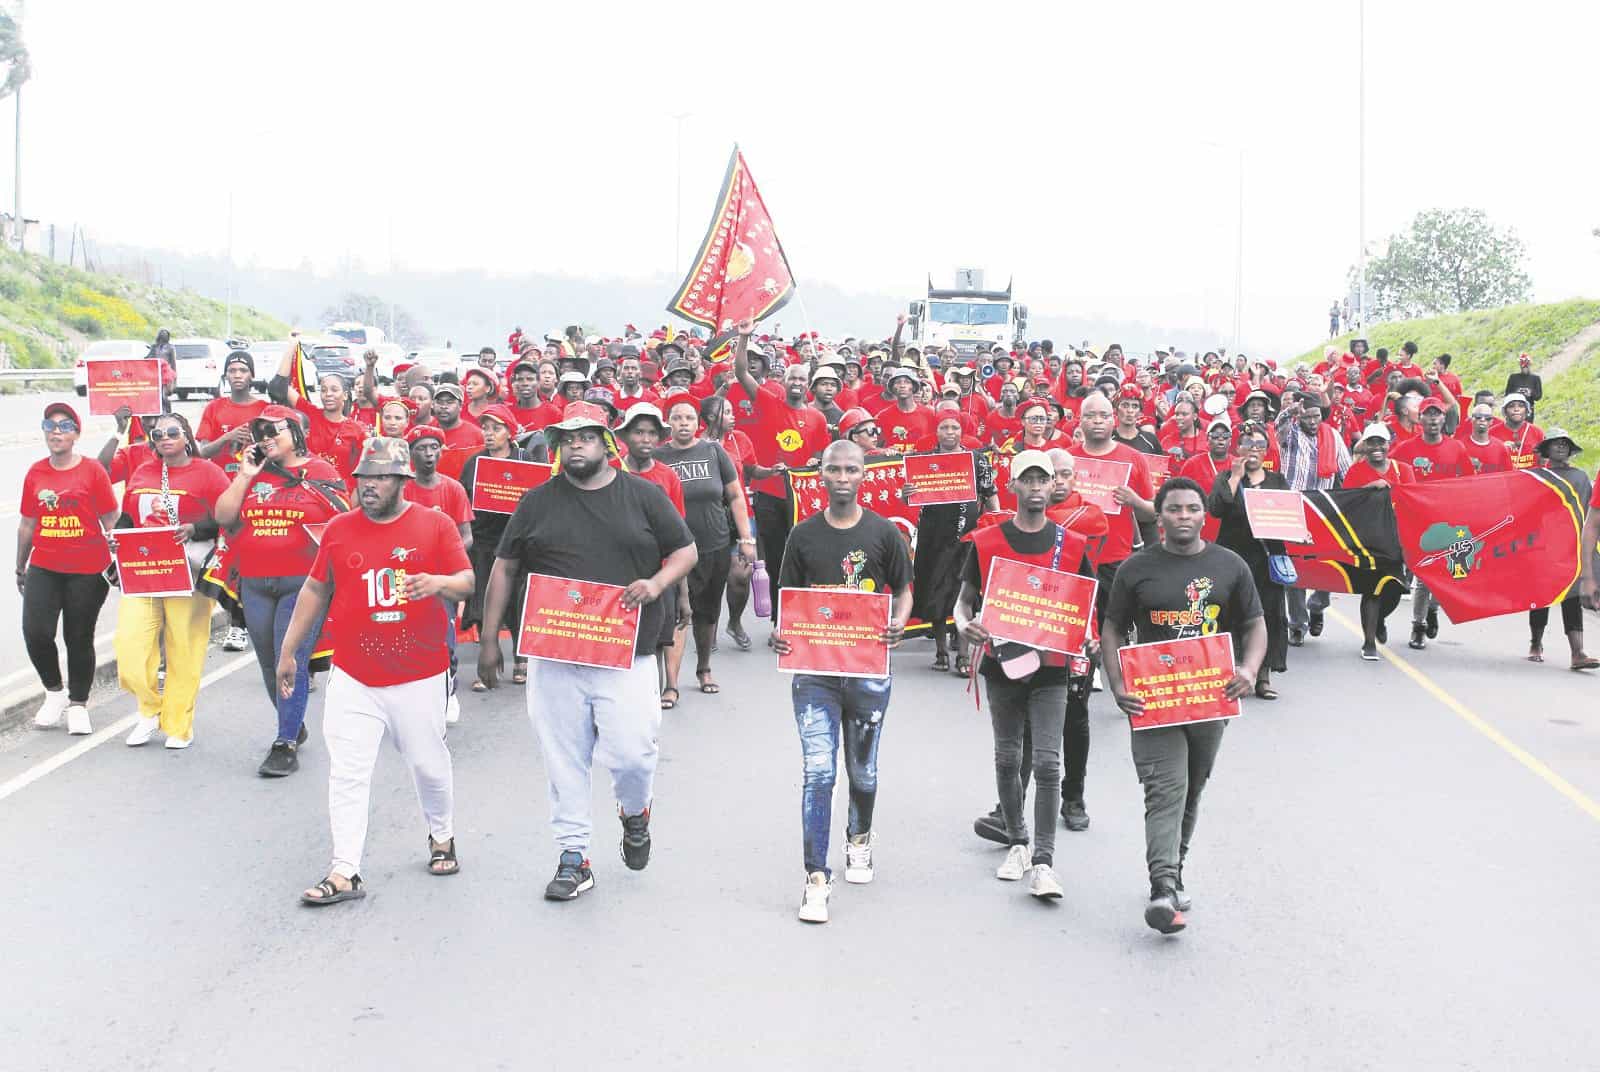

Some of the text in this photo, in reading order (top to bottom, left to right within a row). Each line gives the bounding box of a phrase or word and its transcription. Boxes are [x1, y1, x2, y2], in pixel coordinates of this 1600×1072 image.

[41, 516, 80, 528] EFF 10TH
[247, 509, 264, 518] AM
[268, 509, 283, 517] AN
[286, 510, 305, 519] EFF
[1493, 531, 1540, 559] EFF
[156, 558, 185, 567] POLICE
[133, 568, 174, 576] VISIBILITY
[361, 567, 397, 608] 10
[997, 588, 1080, 614] PLESSISLAER
[537, 607, 625, 626] AMAPHOYISA ASE
[987, 598, 1087, 627] POLICE STATION
[1151, 610, 1203, 626] EFFSC
[1000, 613, 1068, 635] MUST FALL
[577, 633, 632, 646] NGALUTHO
[1133, 667, 1222, 686] PLESSISLAER
[1144, 693, 1218, 711] MUST FALL
